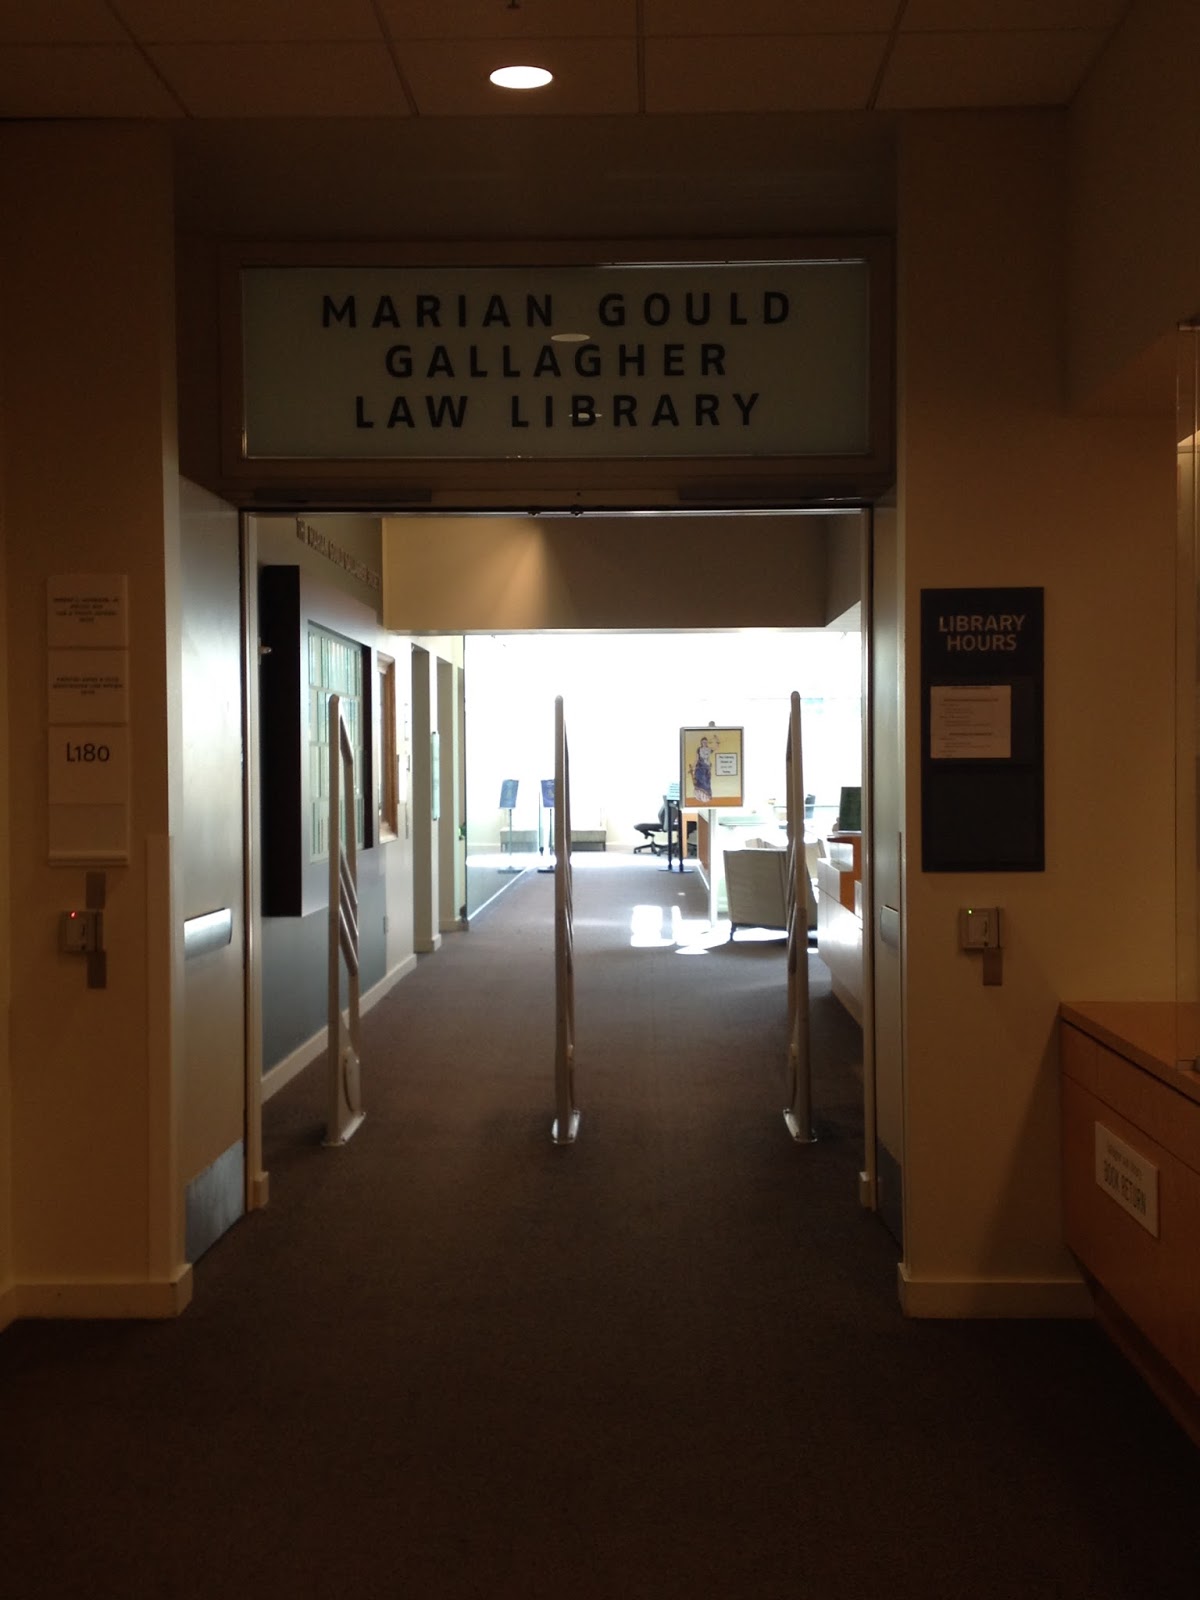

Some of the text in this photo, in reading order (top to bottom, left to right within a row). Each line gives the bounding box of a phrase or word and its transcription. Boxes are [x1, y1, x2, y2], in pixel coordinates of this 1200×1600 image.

[322, 291, 790, 328] MARIAN GOULD
[385, 344, 726, 378] GALLAGHER
[355, 393, 759, 428] LAW LIBRARY
[938, 614, 1026, 632] LIBRARY
[946, 634, 1017, 651] HOURS
[66, 742, 110, 762] L180
